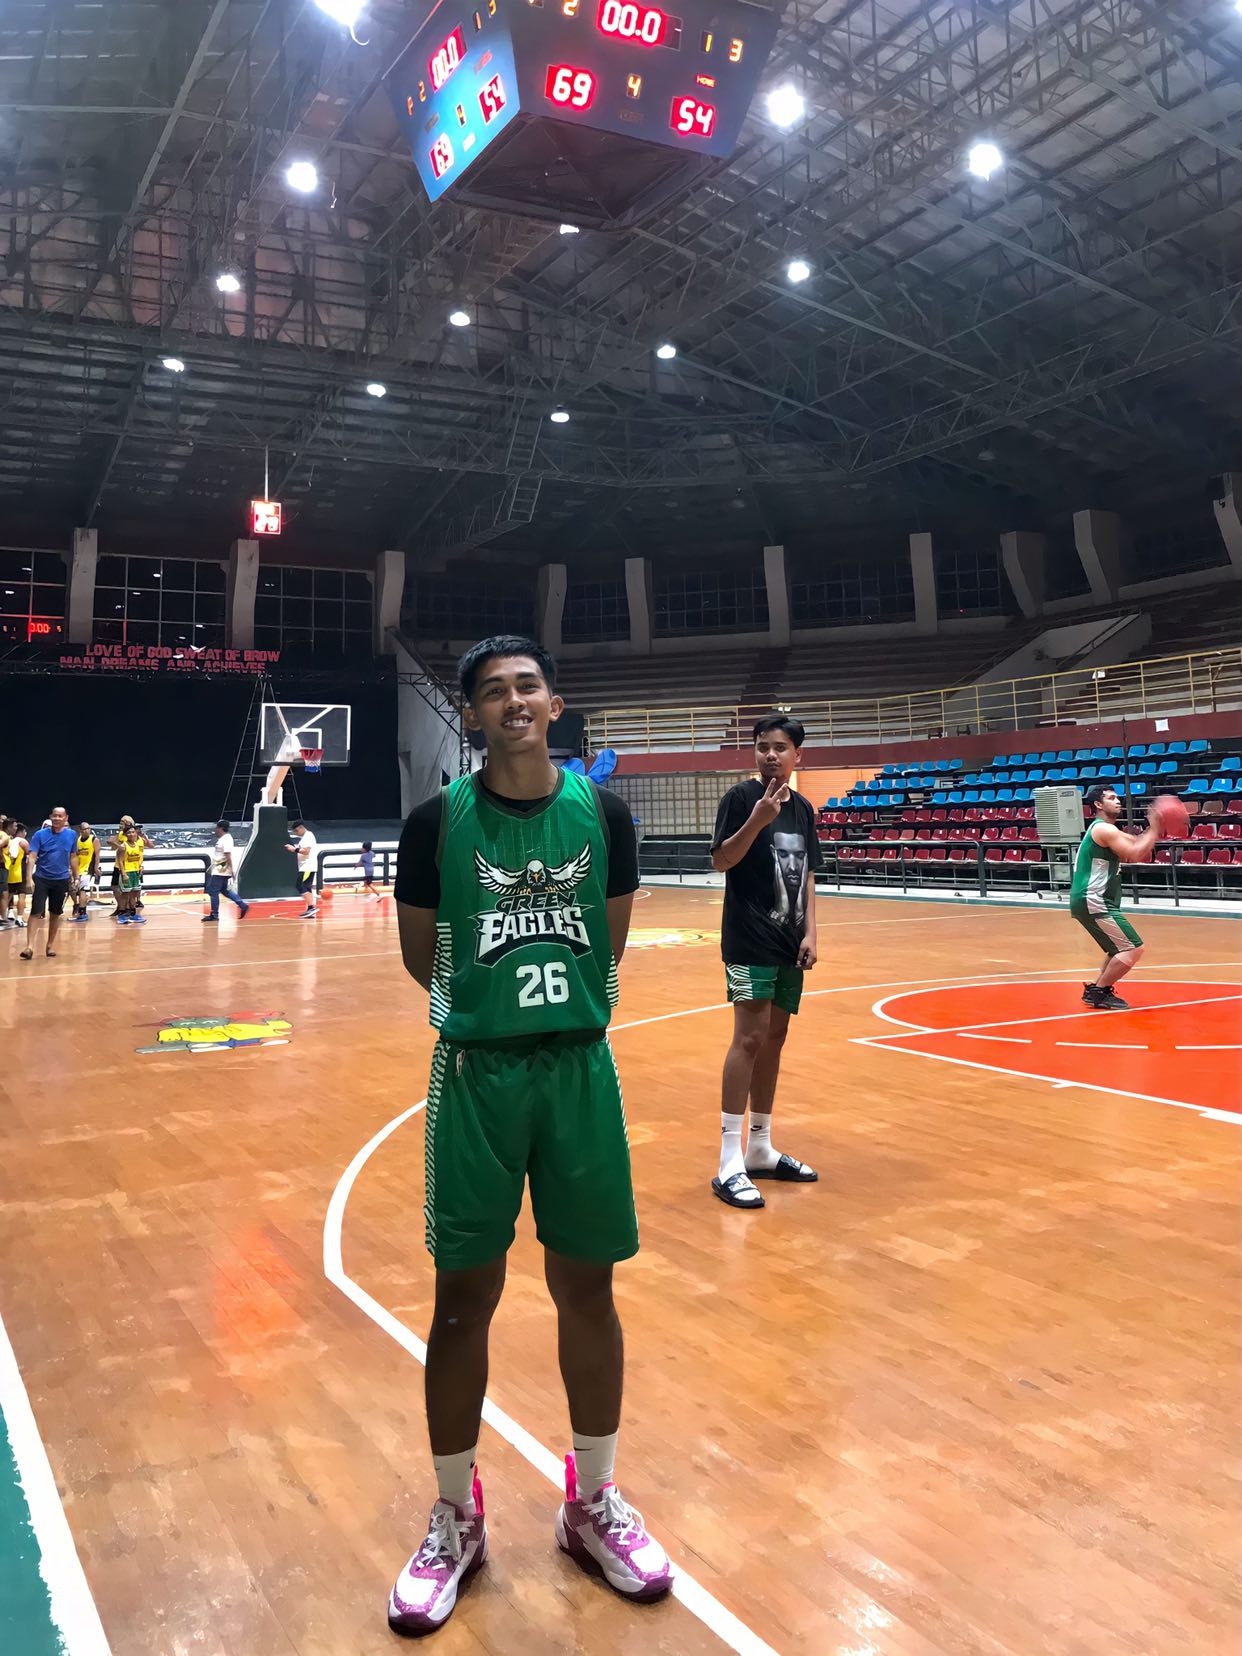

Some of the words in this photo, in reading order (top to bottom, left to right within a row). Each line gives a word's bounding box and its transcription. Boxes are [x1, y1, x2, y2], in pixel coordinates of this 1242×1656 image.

[601, 1, 661, 43] 00.0
[728, 39, 743, 62] 3
[552, 68, 592, 106] 69
[627, 76, 641, 97] 4
[677, 99, 713, 133] 54
[86, 643, 122, 657] LOVE
[128, 645, 144, 657] OF
[147, 646, 172, 659] GOD
[175, 647, 222, 660] SWEAT
[225, 649, 241, 661] OF
[244, 650, 280, 662] BROW
[495, 892, 577, 914] GREEN
[476, 906, 592, 959] EAGLES
[516, 961, 570, 1008] 26
